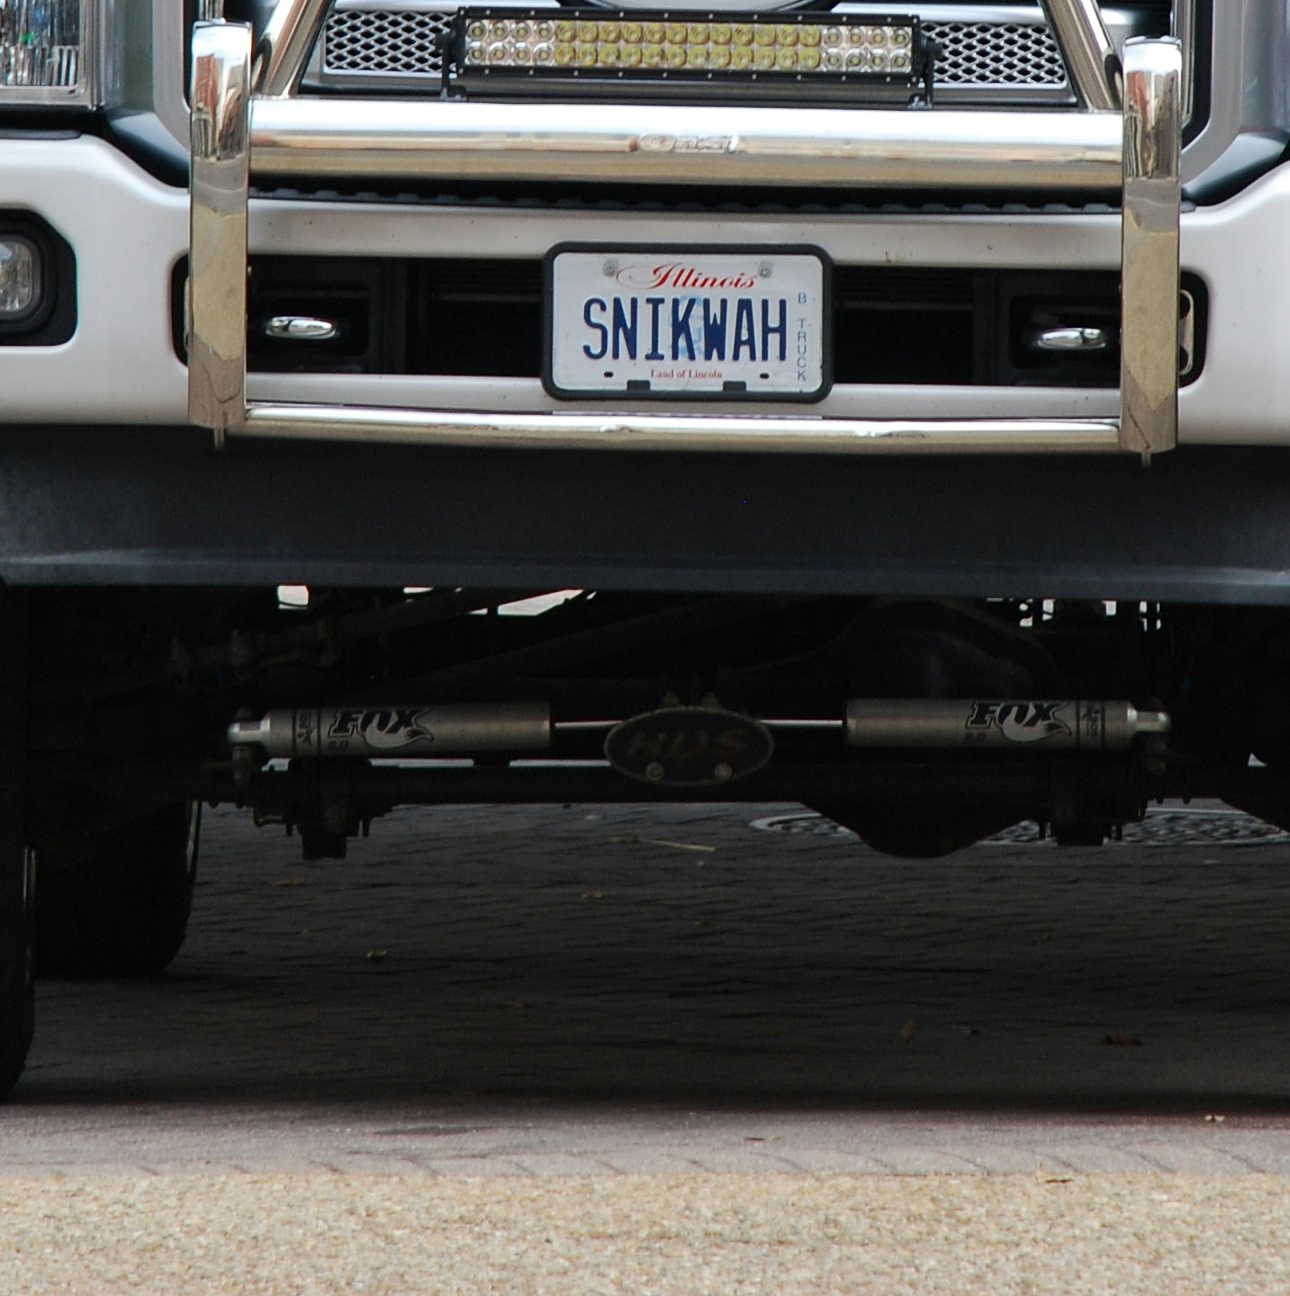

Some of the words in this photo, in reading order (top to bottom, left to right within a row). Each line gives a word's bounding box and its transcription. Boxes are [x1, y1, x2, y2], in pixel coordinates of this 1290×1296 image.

[616, 262, 760, 290] Illinois
[797, 292, 808, 305] B
[582, 296, 788, 362] SNIKWAH
[796, 318, 808, 381] TRUCK
[650, 368, 674, 379] Land
[676, 368, 687, 379] of
[688, 368, 723, 379] Lincoln
[328, 707, 432, 744] FOX
[965, 701, 1069, 736] FOX
